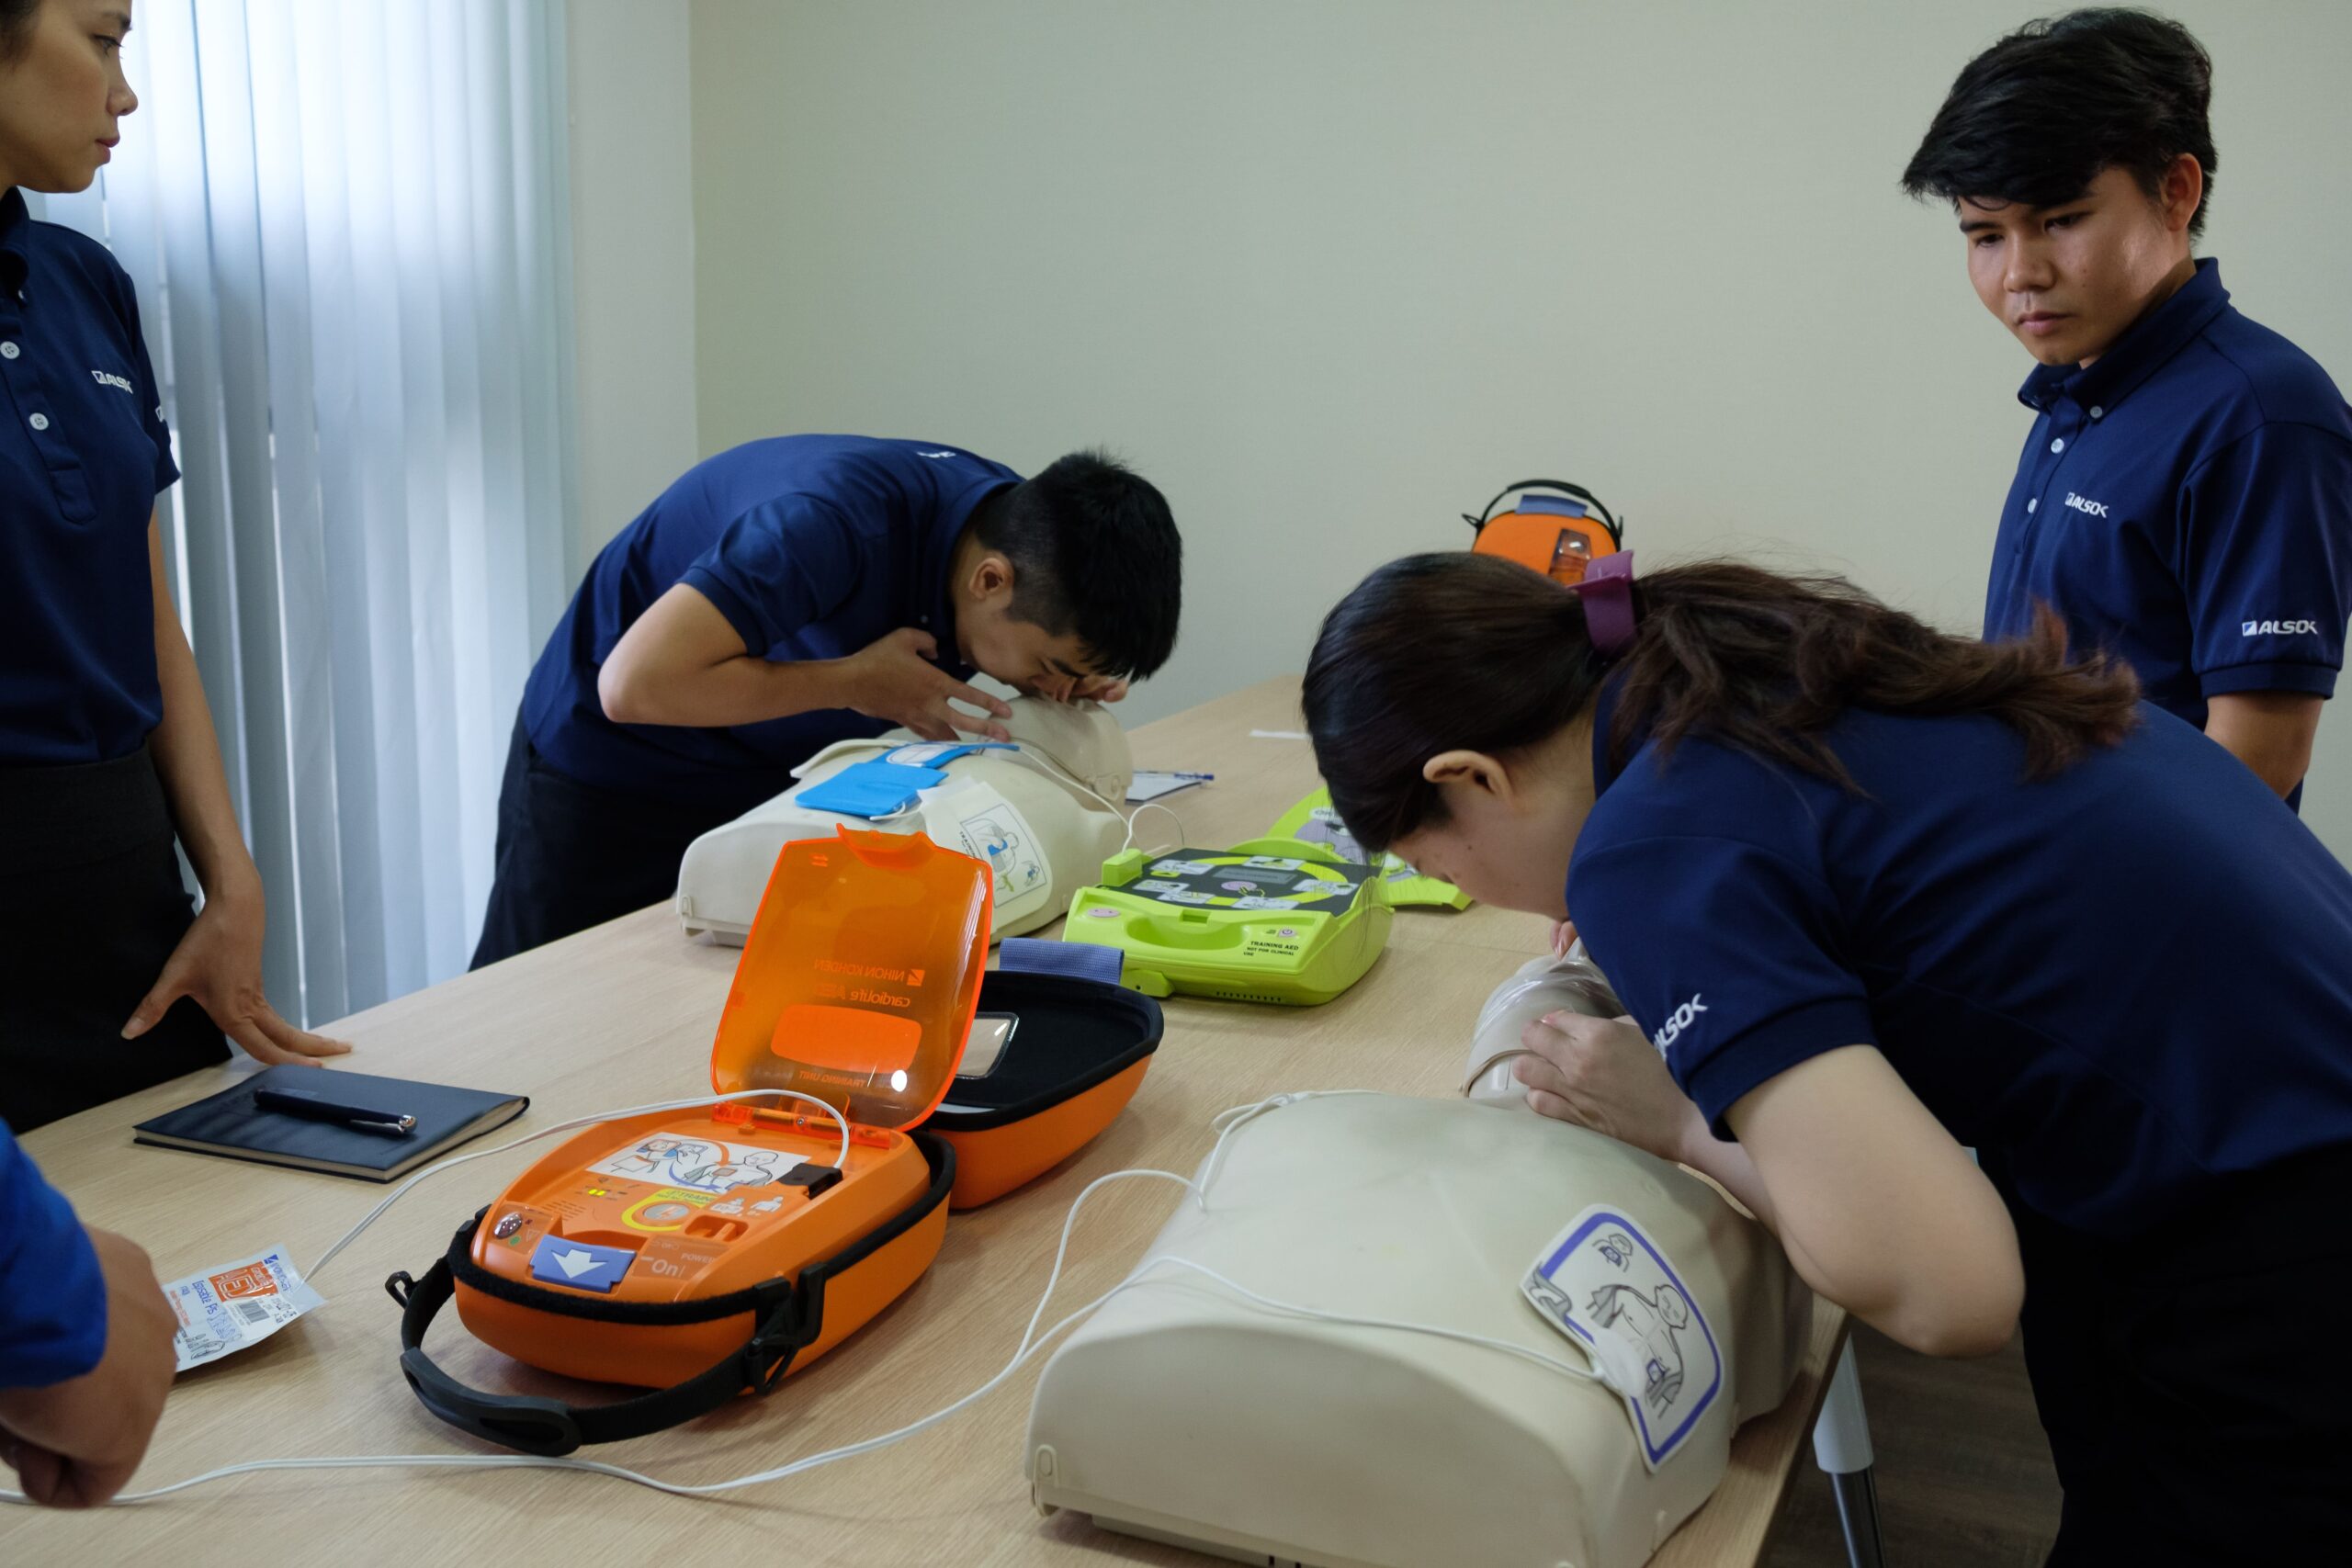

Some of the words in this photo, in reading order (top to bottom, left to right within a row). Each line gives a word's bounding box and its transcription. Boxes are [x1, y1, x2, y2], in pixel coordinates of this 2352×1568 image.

[2072, 495, 2109, 518] ALSOK
[2258, 619, 2318, 636] ALSOK
[1250, 941, 1283, 949] TRAINING
